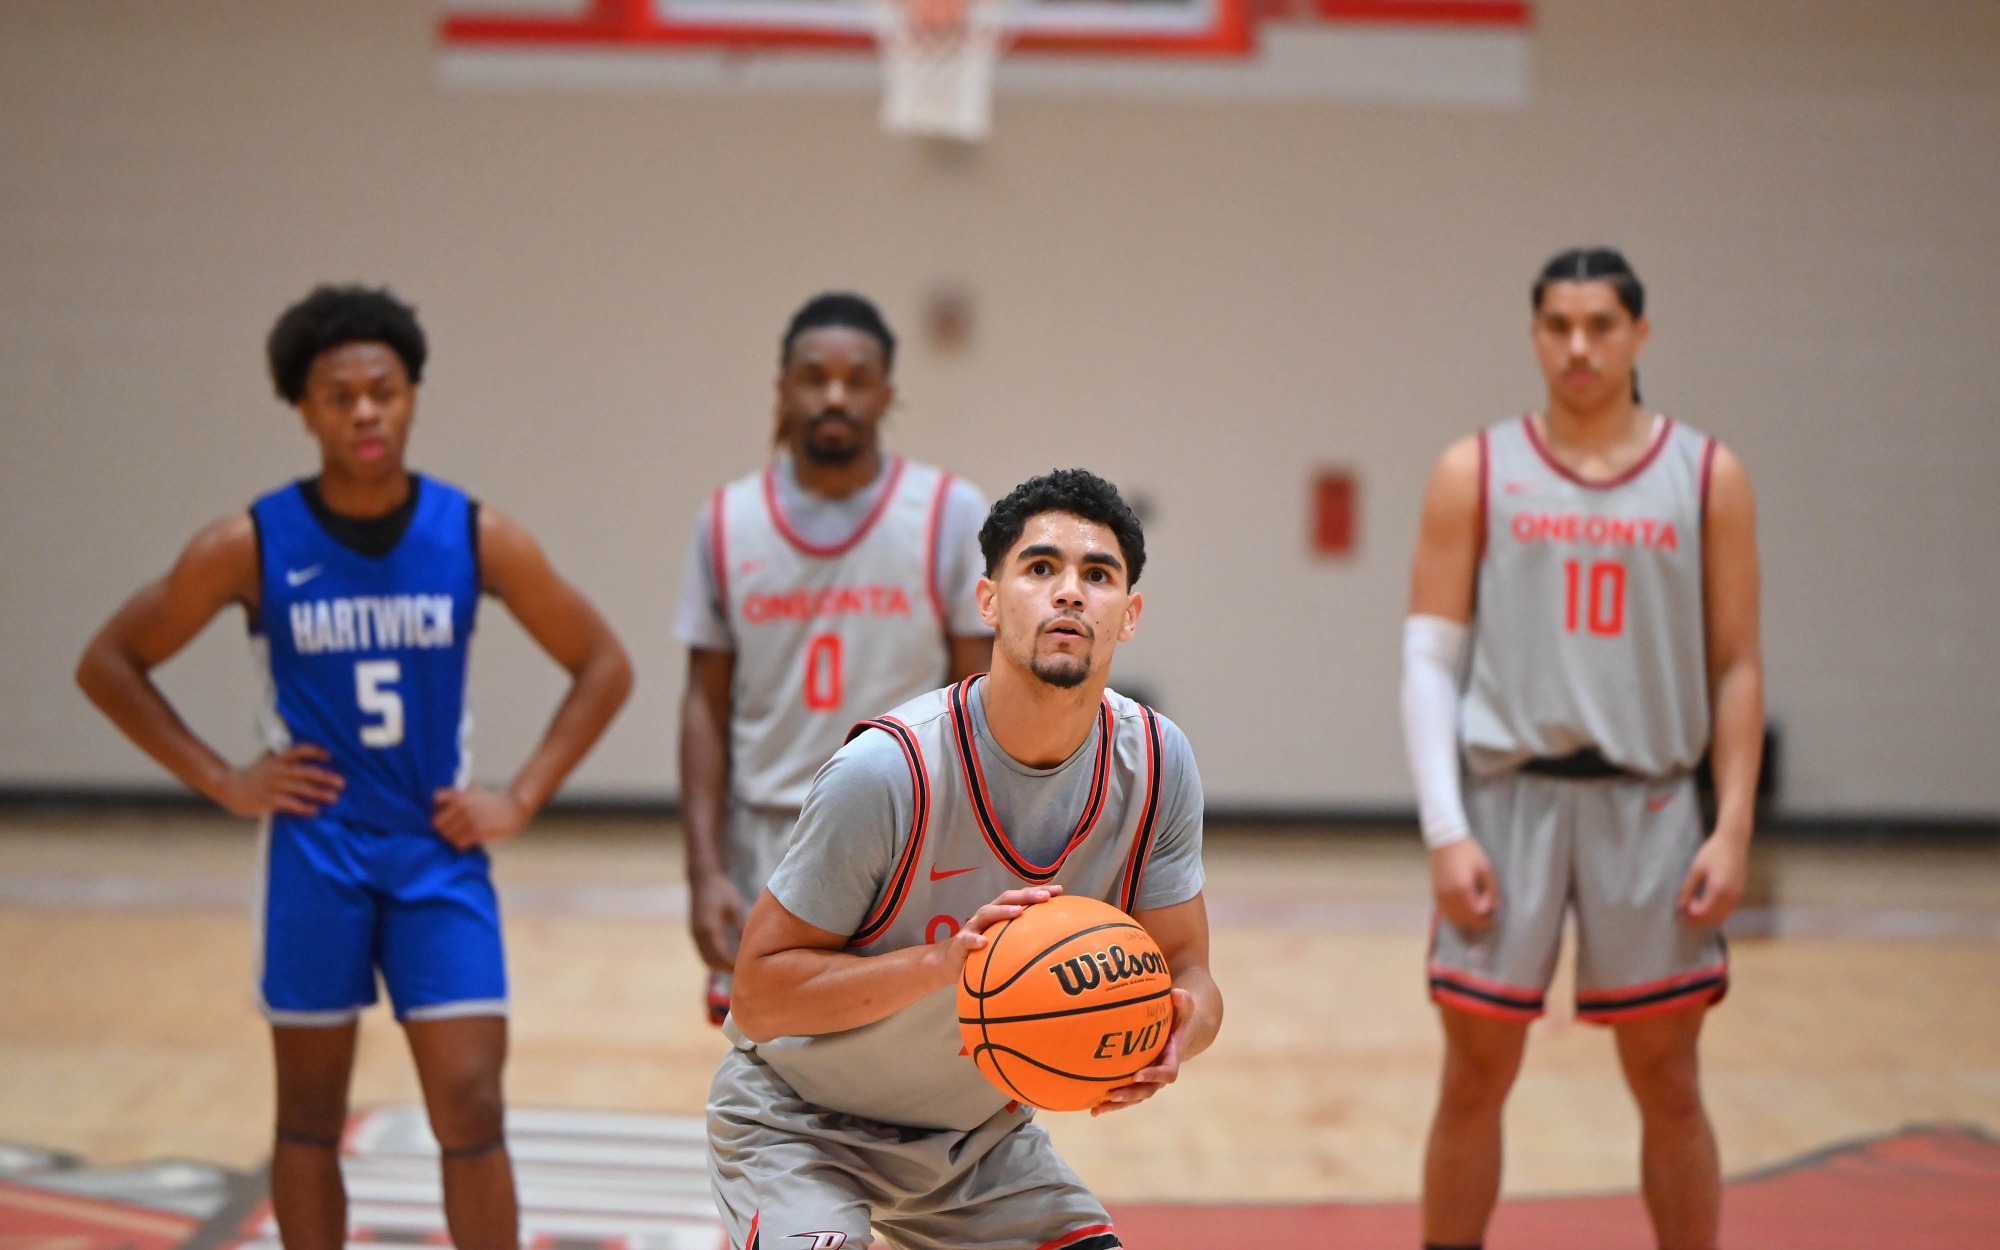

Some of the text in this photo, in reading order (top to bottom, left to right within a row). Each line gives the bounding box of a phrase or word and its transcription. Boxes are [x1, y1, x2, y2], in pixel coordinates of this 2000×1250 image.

[1510, 512, 1678, 553] ONEONTA
[289, 593, 454, 656] HARTWICK
[742, 583, 912, 625] ONEONTA
[1564, 555, 1627, 638] 10
[804, 630, 844, 713] 0
[354, 659, 405, 748] 5
[1048, 944, 1169, 997] Wilson
[1093, 1020, 1162, 1059] EVO
